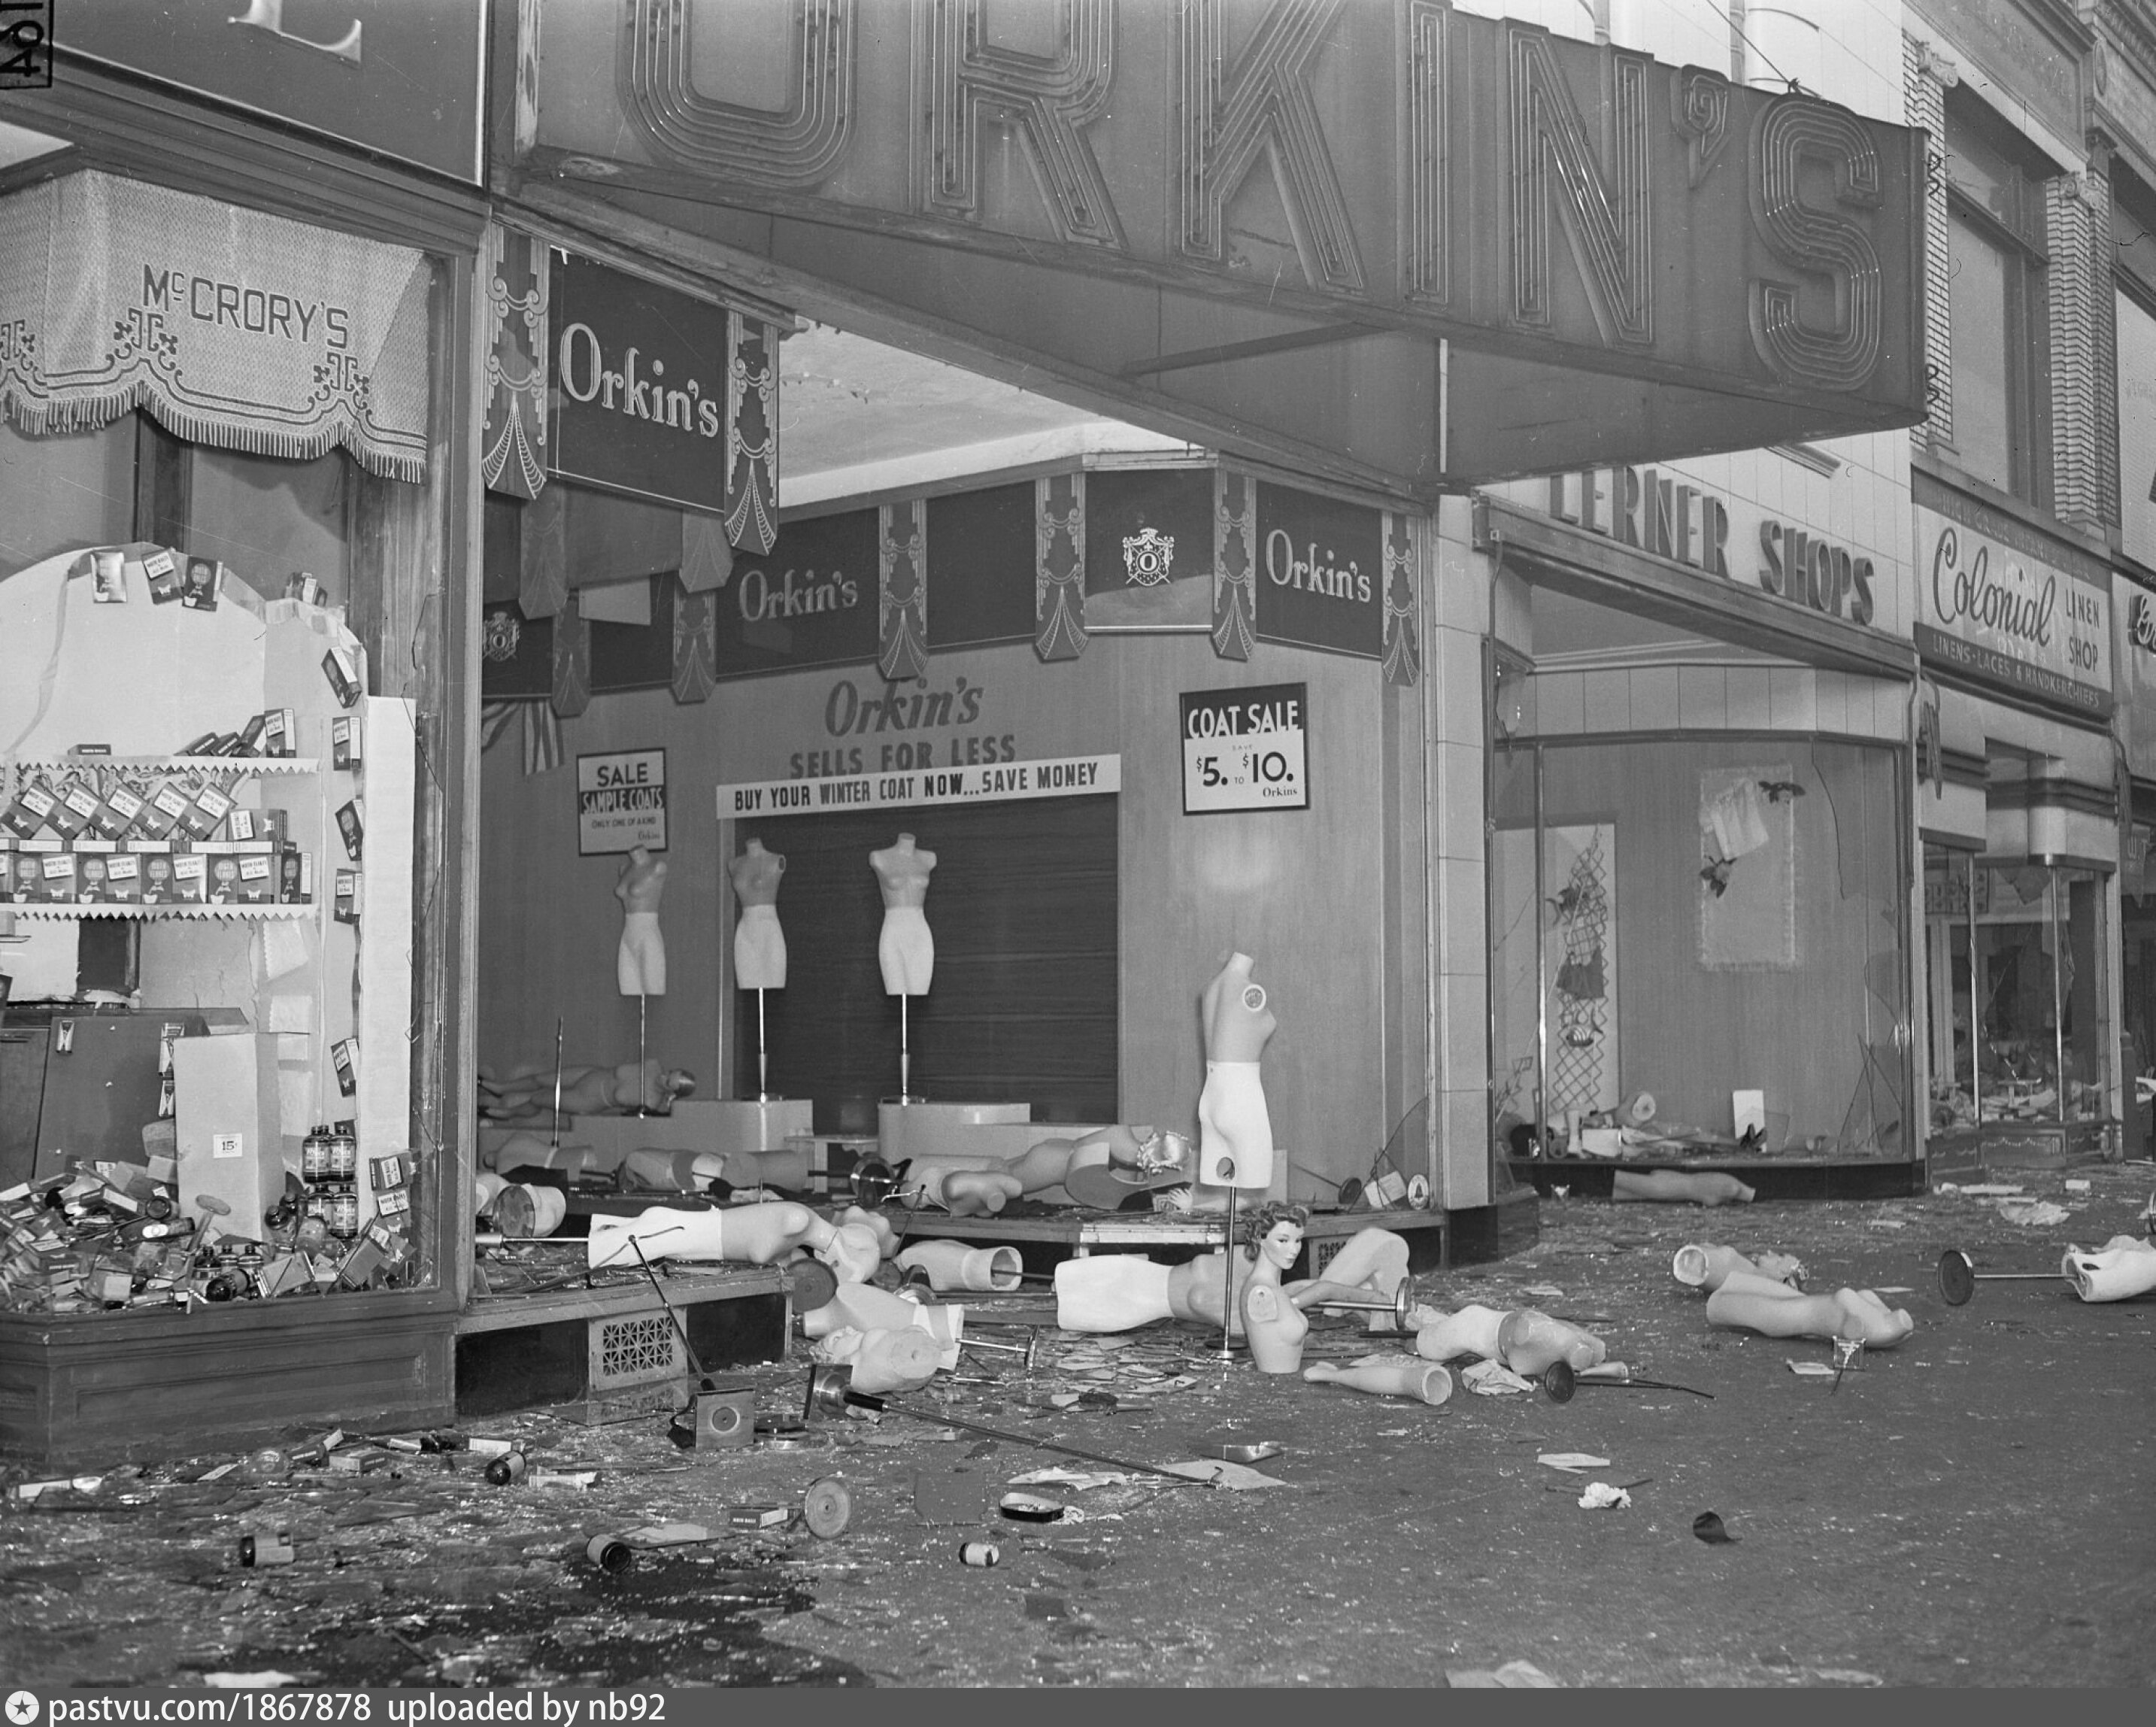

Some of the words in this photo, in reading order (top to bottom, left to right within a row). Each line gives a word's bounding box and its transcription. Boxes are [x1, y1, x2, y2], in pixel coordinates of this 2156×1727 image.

[559, 322, 720, 439] Orkin's
[1266, 529, 1371, 603] Orkin's
[1759, 520, 1874, 626] SHOPS
[1933, 527, 2055, 647] Colonial
[738, 569, 859, 621] Orkin's
[2066, 588, 2100, 630] LINEN
[2069, 636, 2098, 672] SHOP
[825, 676, 984, 737] Orkin's
[1188, 706, 1241, 739] COAT
[1247, 700, 1299, 734] SALE
[597, 763, 648, 787] SALE
[791, 748, 864, 779] SELLS
[881, 741, 932, 772] FOR
[951, 734, 1015, 767] LESS
[583, 789, 626, 813] SAMPLE
[629, 787, 663, 811] COATS
[735, 790, 763, 811] BUY
[771, 785, 811, 809] YOUR
[819, 780, 871, 805] WINTER
[879, 777, 914, 800] COAT
[1037, 762, 1098, 789] MONEY
[1234, 776, 1245, 785] TO
